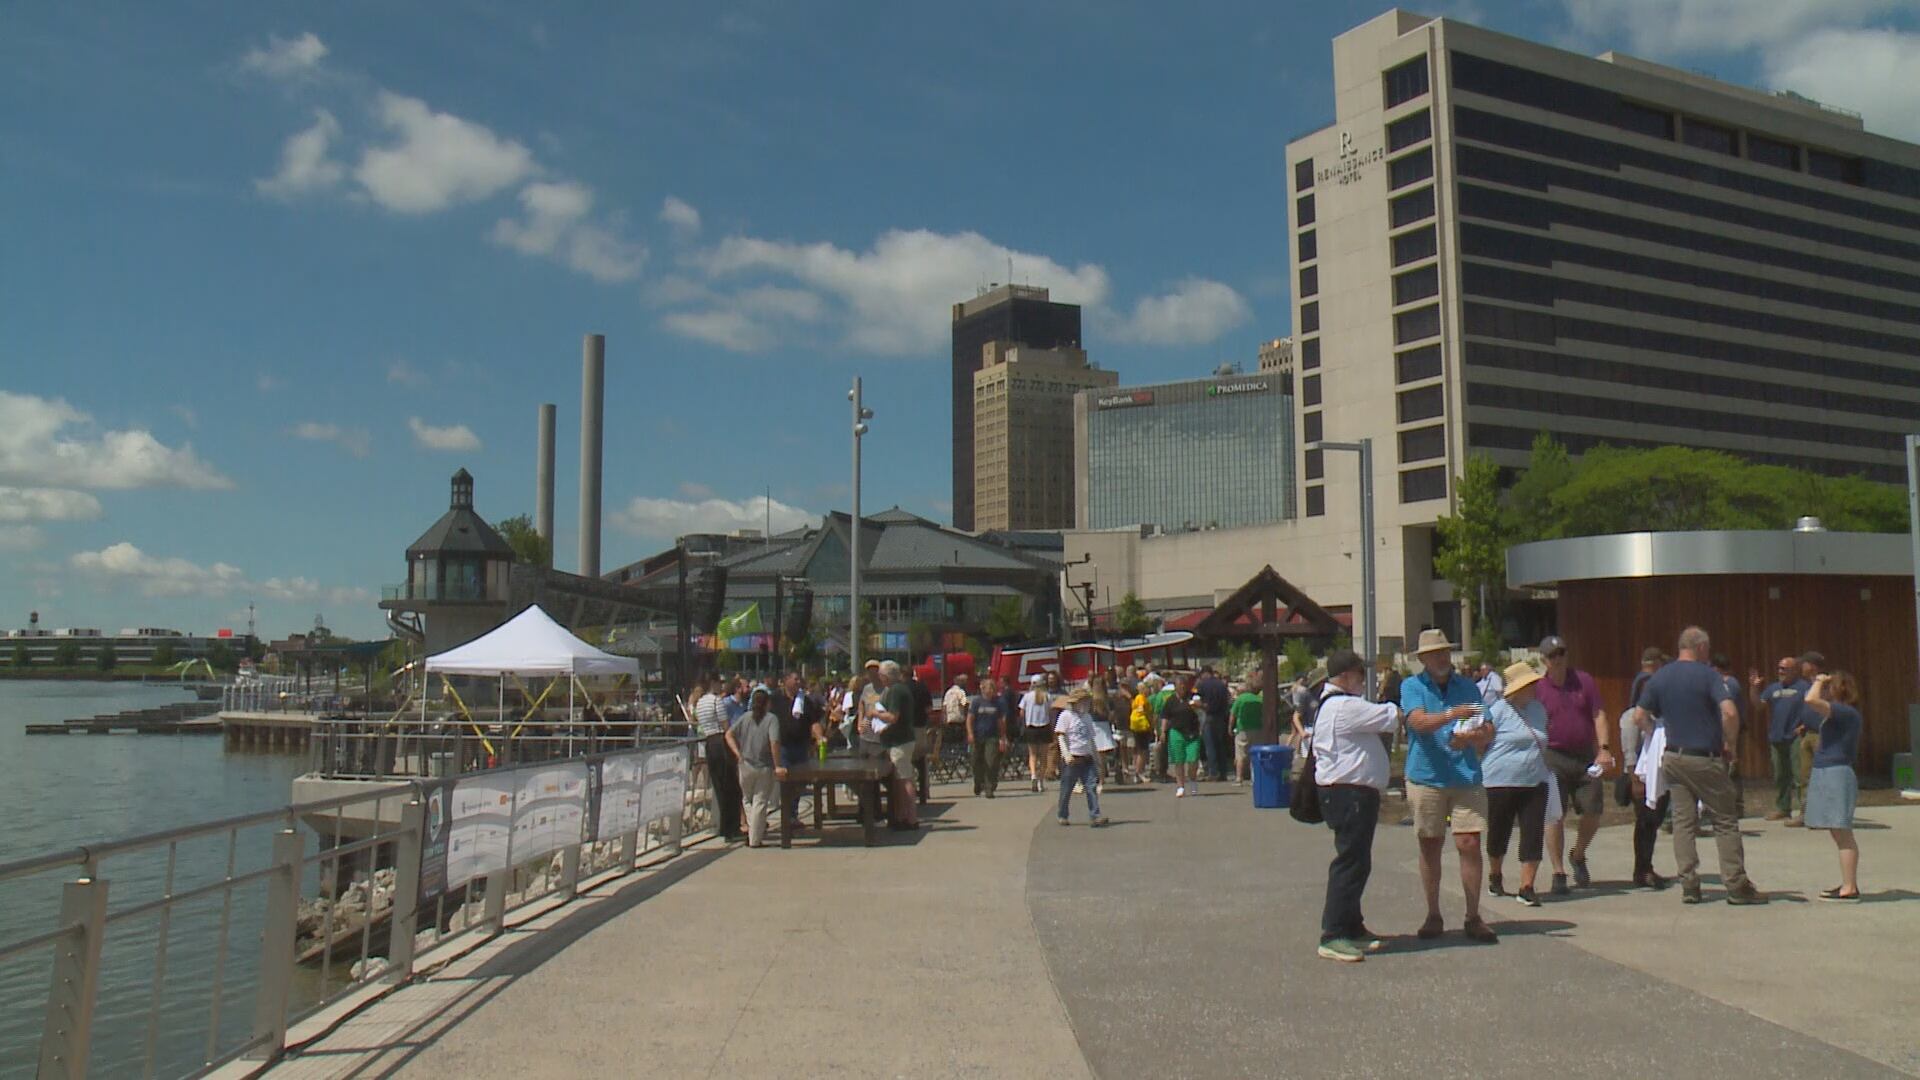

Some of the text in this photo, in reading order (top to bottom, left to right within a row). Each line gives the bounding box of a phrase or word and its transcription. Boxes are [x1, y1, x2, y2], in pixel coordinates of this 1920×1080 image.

[1339, 130, 1358, 160] R
[1317, 147, 1384, 183] RENAISSANCE
[1339, 170, 1362, 186] HOTEL
[1098, 395, 1134, 408] KeyBank
